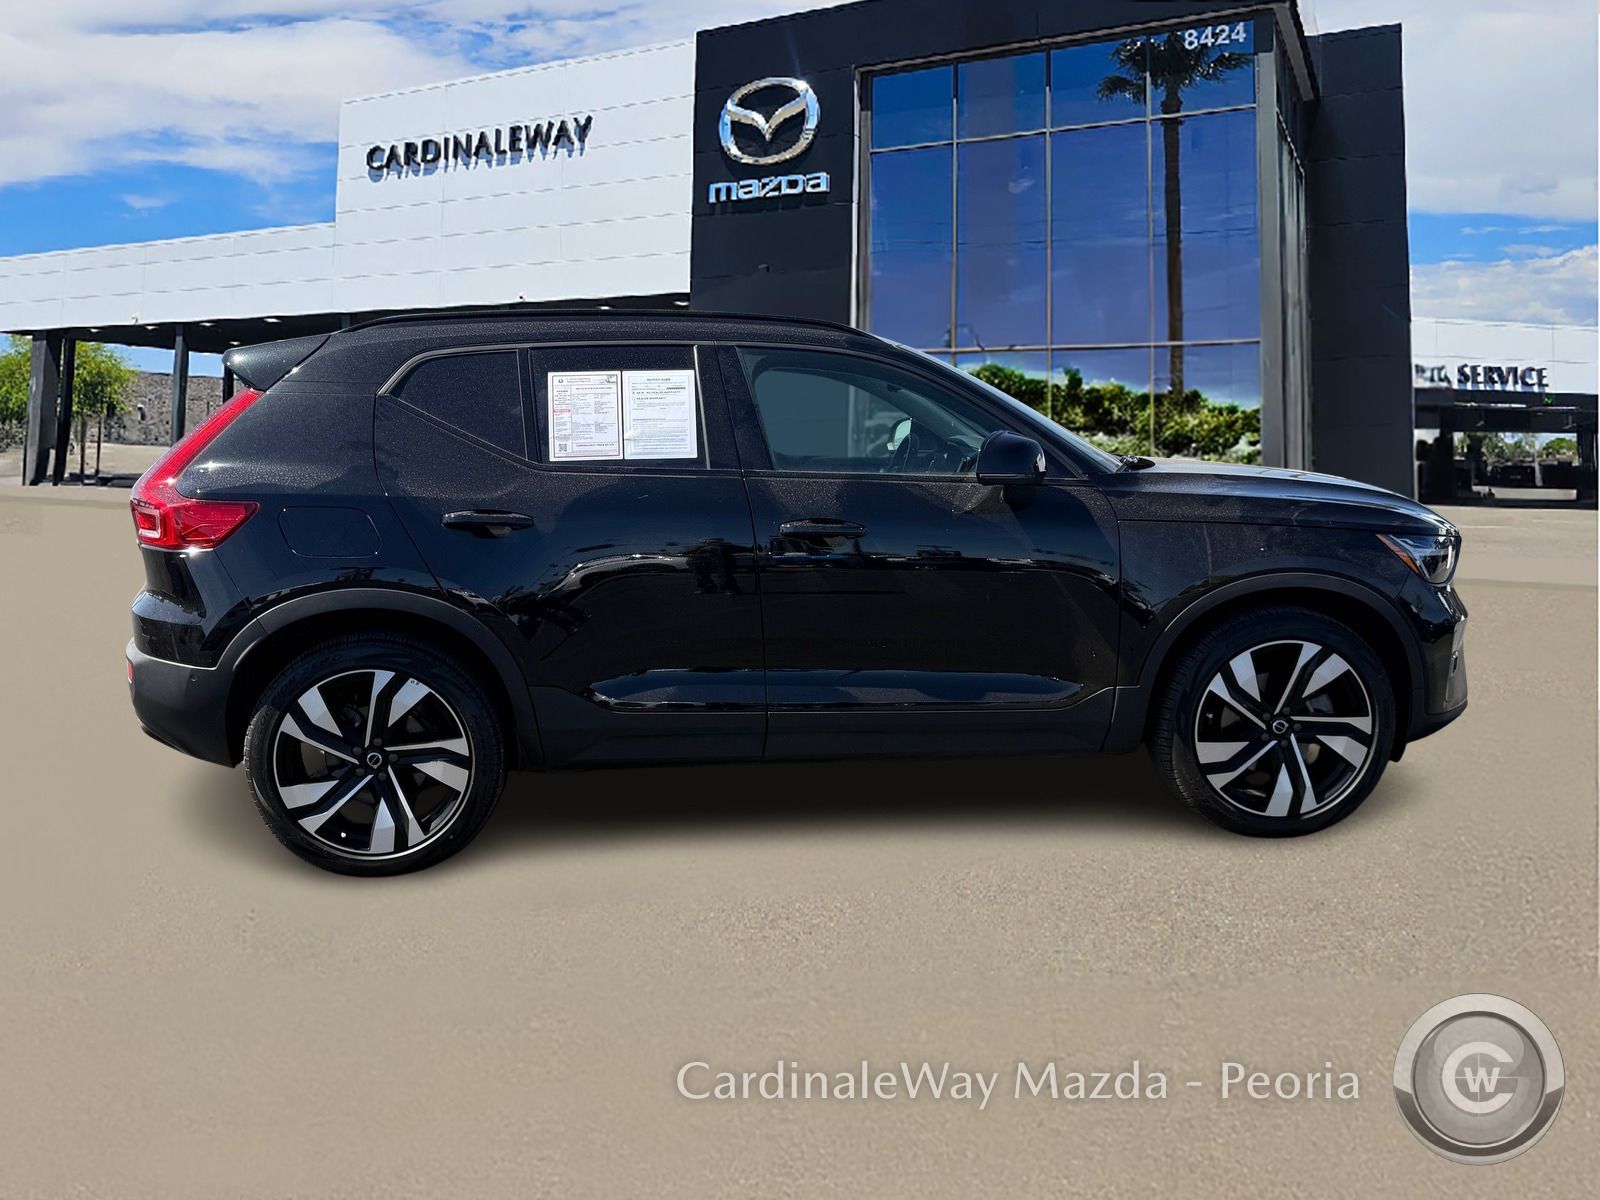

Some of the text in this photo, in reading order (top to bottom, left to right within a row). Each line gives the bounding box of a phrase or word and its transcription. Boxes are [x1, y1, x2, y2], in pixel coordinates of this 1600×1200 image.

[1184, 22, 1246, 50] 8424
[366, 115, 593, 171] CARDINALEWAY
[708, 172, 830, 204] mazda
[1457, 363, 1549, 387] SERVICE
